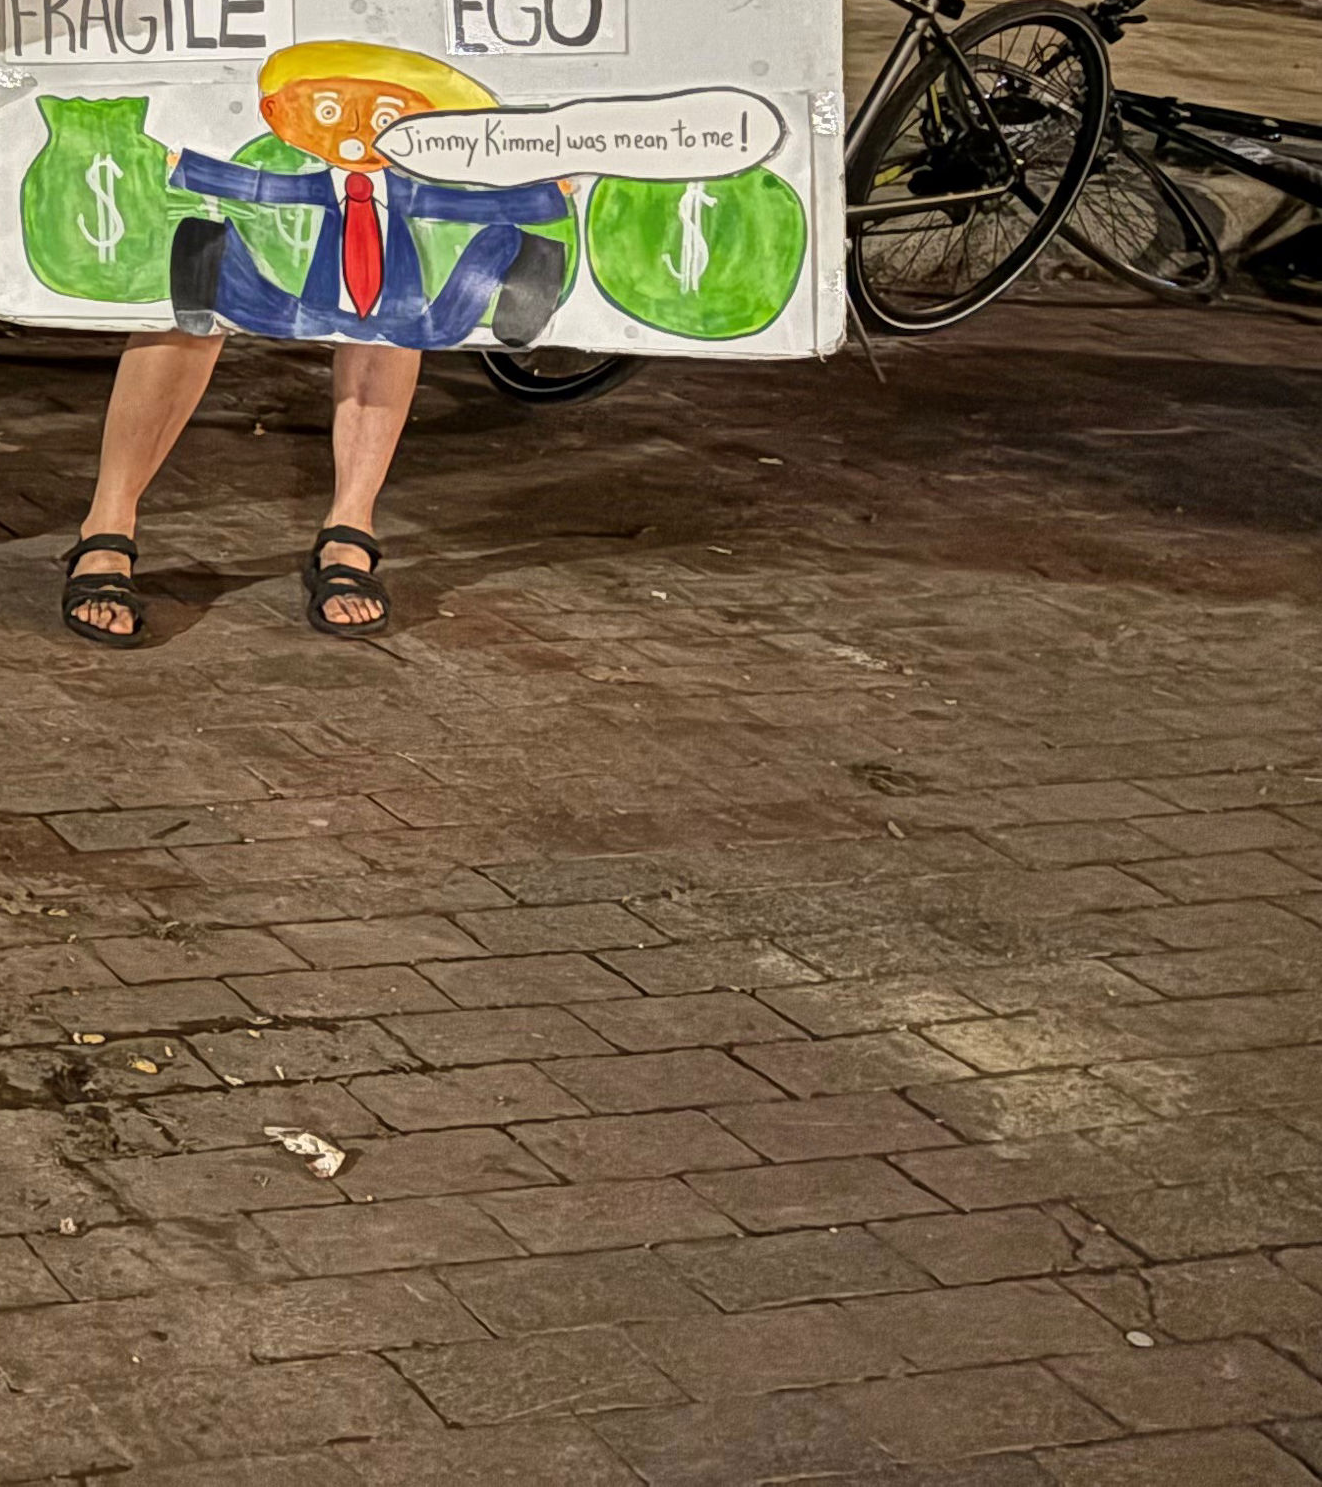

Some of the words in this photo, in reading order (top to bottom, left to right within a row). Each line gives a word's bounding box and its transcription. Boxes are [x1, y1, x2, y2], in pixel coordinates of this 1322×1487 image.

[388, 126, 480, 168] Jimmy
[485, 118, 561, 158] Kimmel
[568, 133, 606, 152] was
[615, 129, 668, 151] mean
[671, 119, 697, 148] to
